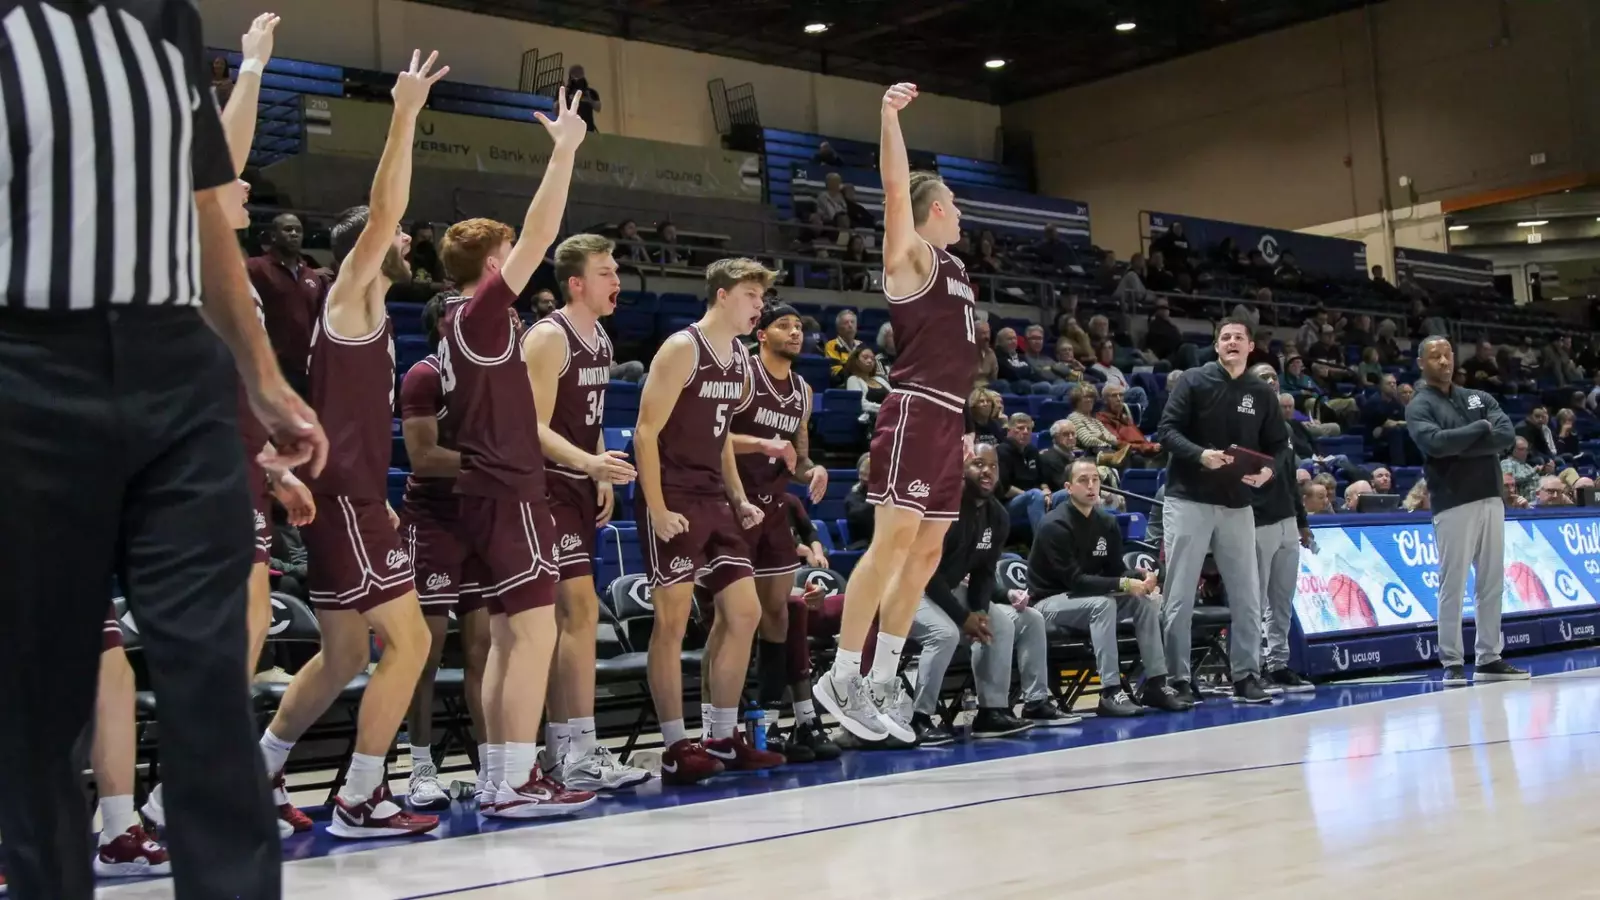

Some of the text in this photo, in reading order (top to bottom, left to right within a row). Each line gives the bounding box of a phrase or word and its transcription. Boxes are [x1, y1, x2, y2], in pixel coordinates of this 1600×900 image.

[413, 140, 471, 155] VERSITY
[489, 145, 524, 162] Bank
[578, 366, 610, 386] MONTAN
[698, 380, 743, 399] MONTAN
[585, 389, 606, 427] 34
[713, 404, 729, 438] 5
[753, 406, 800, 433] MONTAN
[1506, 633, 1530, 644] ucu.org
[1573, 624, 1595, 635] ucu.org
[1352, 650, 1380, 663] ucu.org
